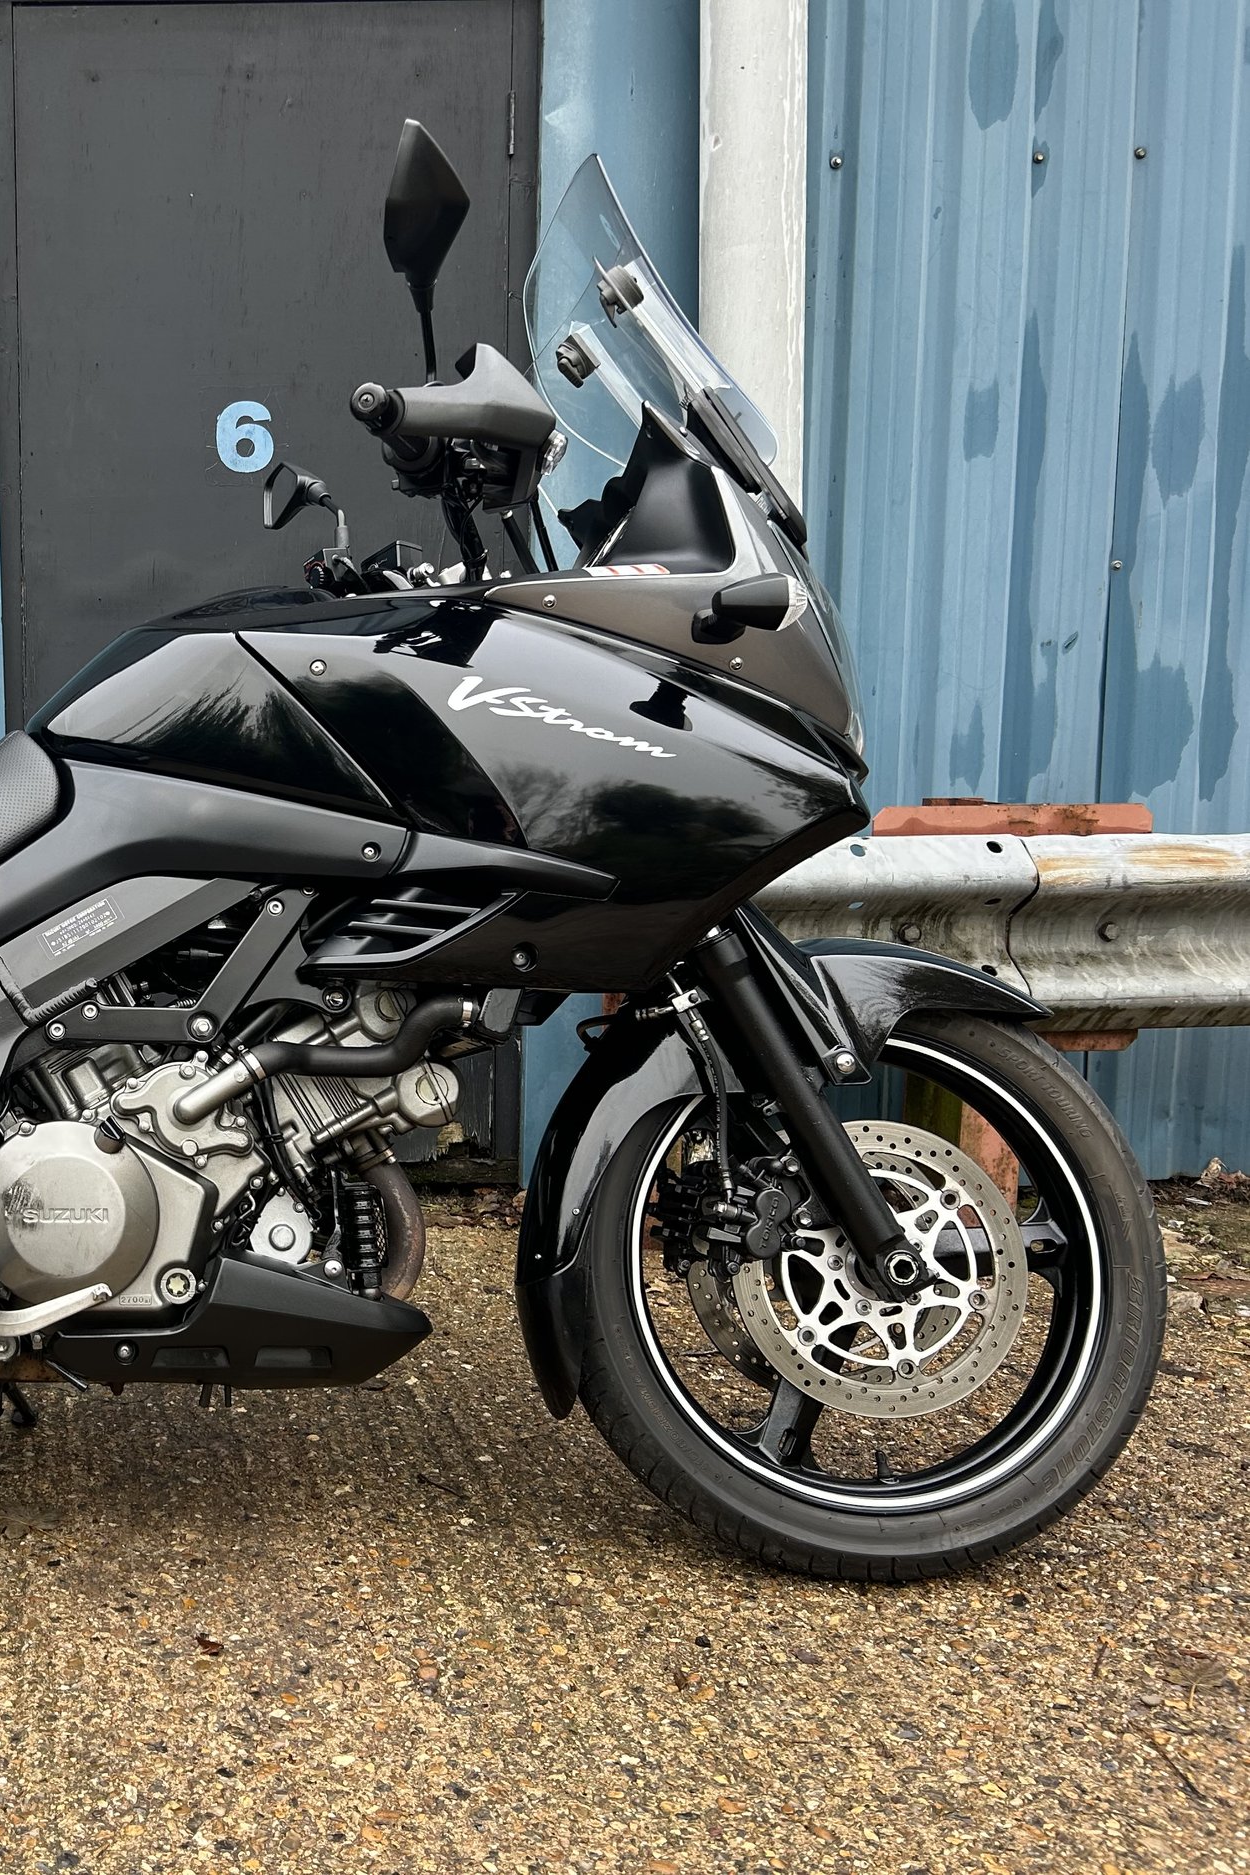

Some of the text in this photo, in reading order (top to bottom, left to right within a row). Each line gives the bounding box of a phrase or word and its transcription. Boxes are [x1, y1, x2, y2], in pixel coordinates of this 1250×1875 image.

[216, 400, 274, 473] 6
[447, 675, 677, 758] V-Strom
[996, 1047, 1095, 1139] SPORT TOURING
[22, 1207, 110, 1224] SUZUKI
[1042, 1270, 1144, 1493] BRIDGESTONE
